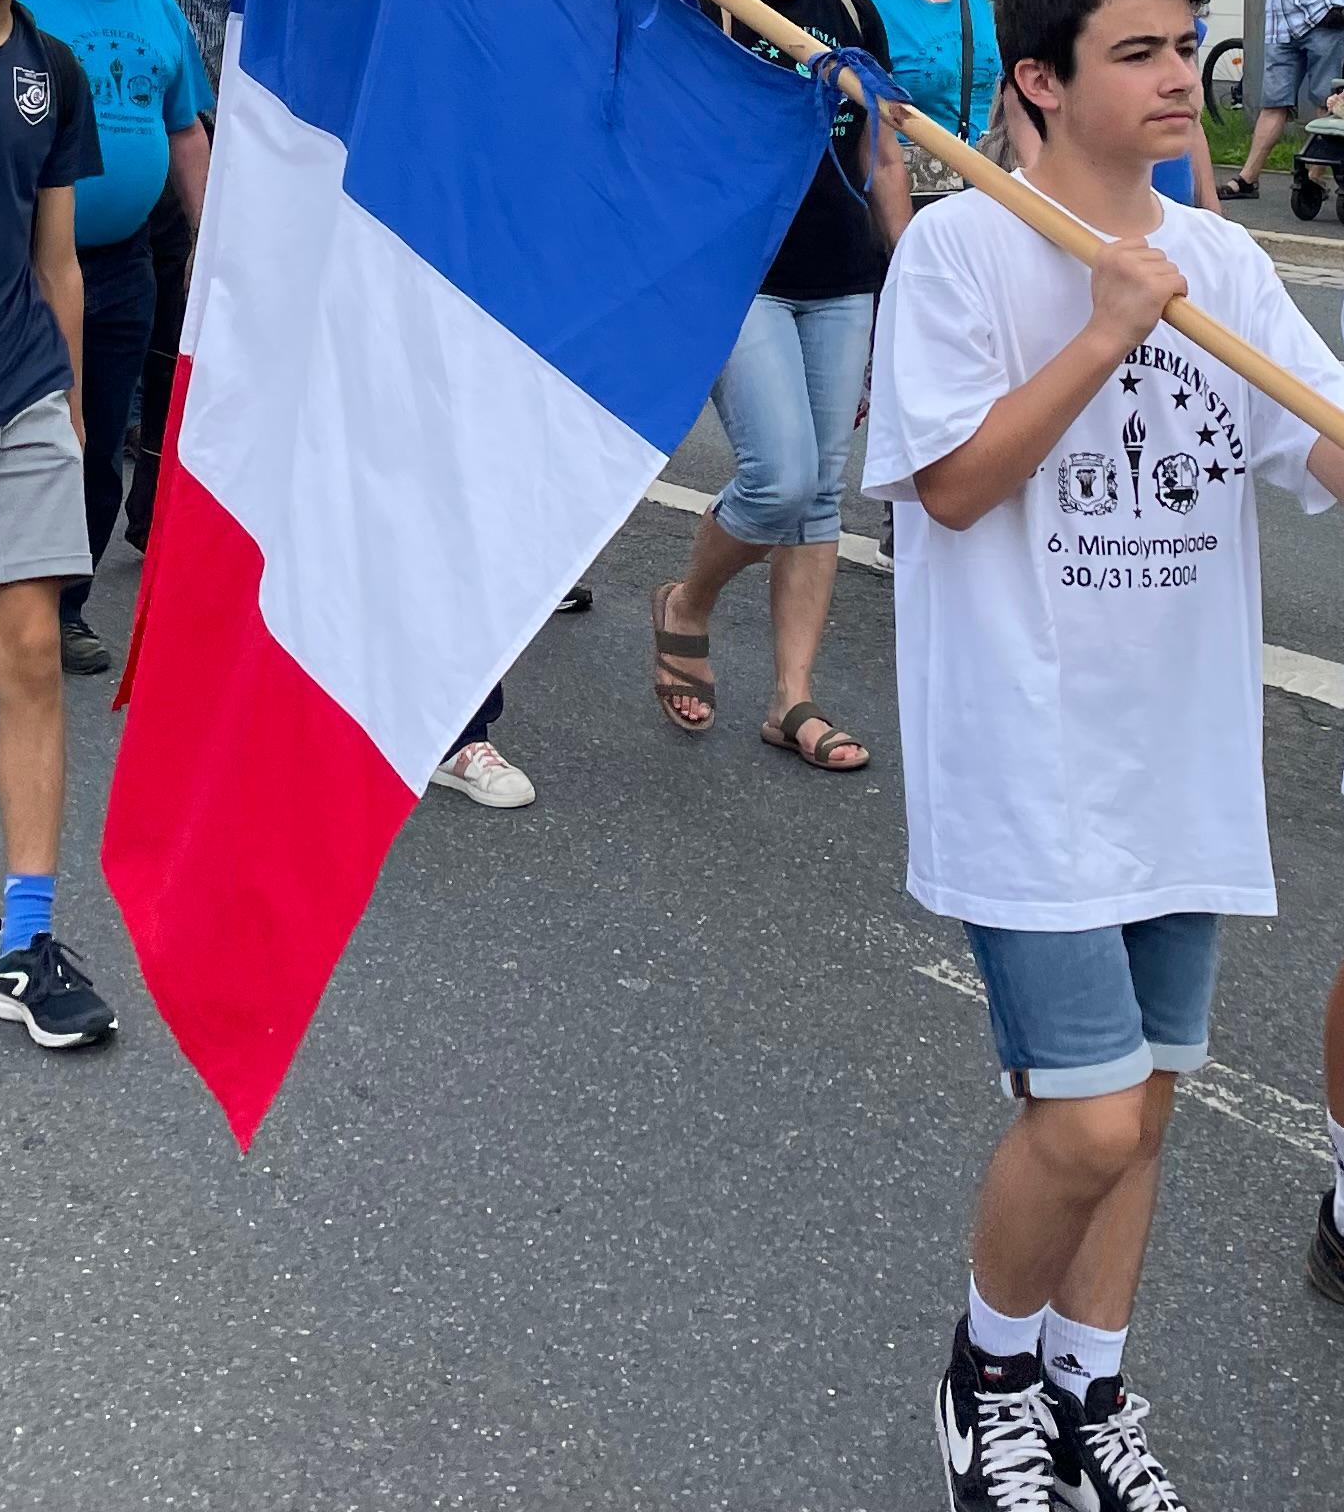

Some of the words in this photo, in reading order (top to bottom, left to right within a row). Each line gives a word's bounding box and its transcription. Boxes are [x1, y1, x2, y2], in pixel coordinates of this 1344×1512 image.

[1047, 532, 1069, 553] 6.
[1078, 531, 1218, 560] Miniolympiade
[1060, 564, 1197, 591] 30./31.5.2004
